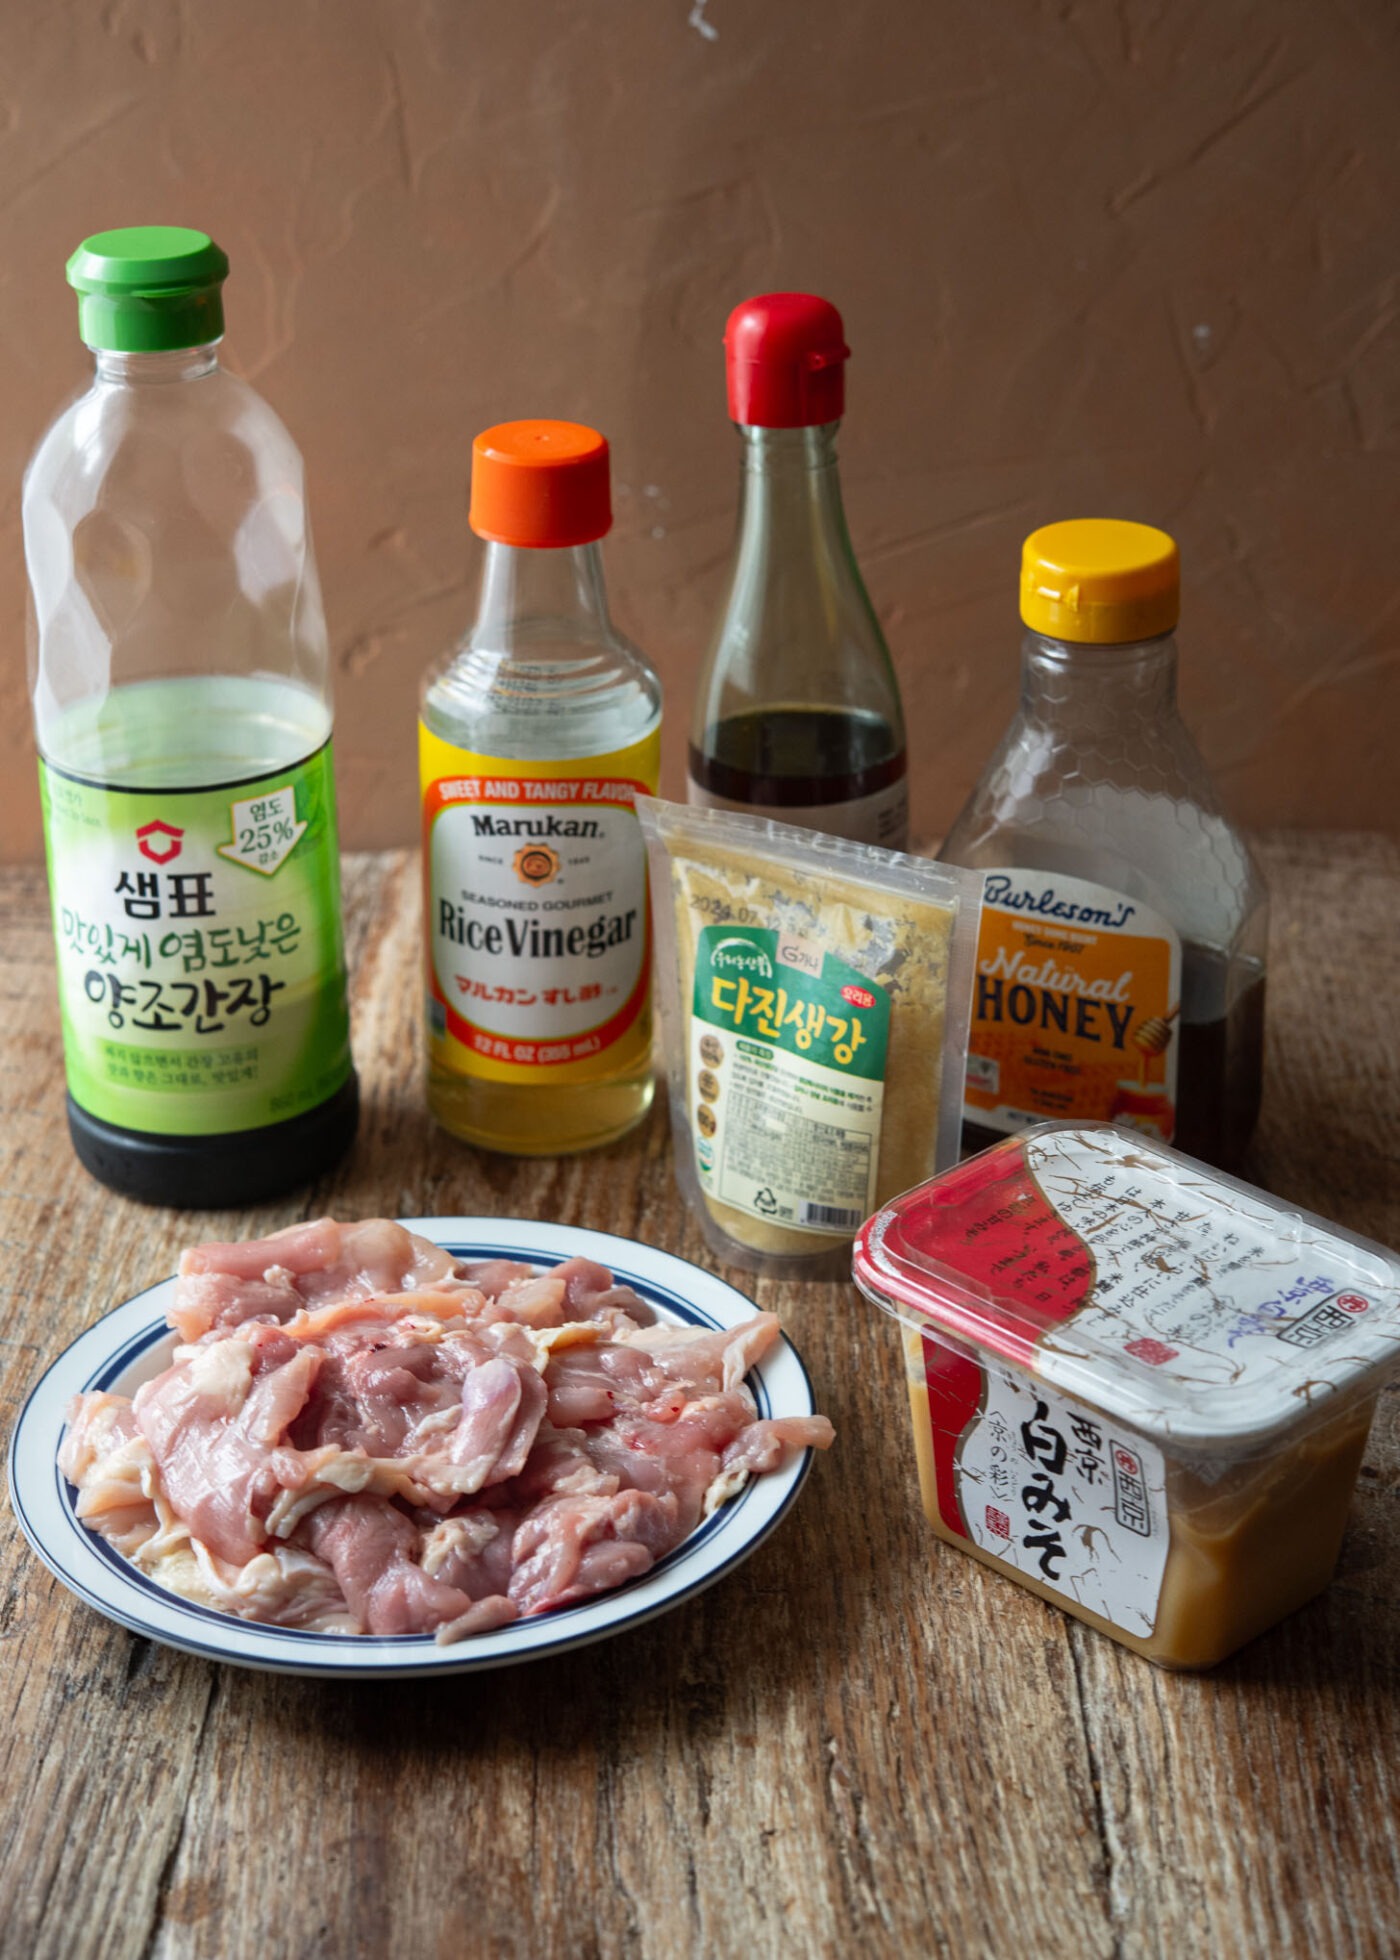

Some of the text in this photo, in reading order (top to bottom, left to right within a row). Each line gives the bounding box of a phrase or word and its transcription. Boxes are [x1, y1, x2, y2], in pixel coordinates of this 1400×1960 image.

[249, 797, 283, 823] 염도
[438, 779, 480, 800] SWEET
[484, 780, 520, 799] AND
[523, 781, 578, 800] TANGY
[239, 816, 294, 853] 25%
[114, 870, 217, 920] 샘표
[461, 890, 614, 912] SEASONED GOURMET
[984, 875, 1135, 927] Burleson's
[61, 906, 301, 974] 맛있게 염도낮은
[84, 969, 286, 1034] 양조간장
[454, 974, 538, 1006] マルカン
[711, 975, 867, 1064] 다진생강
[976, 974, 1135, 1050] HONEY
[513, 1044, 536, 1062] OZ
